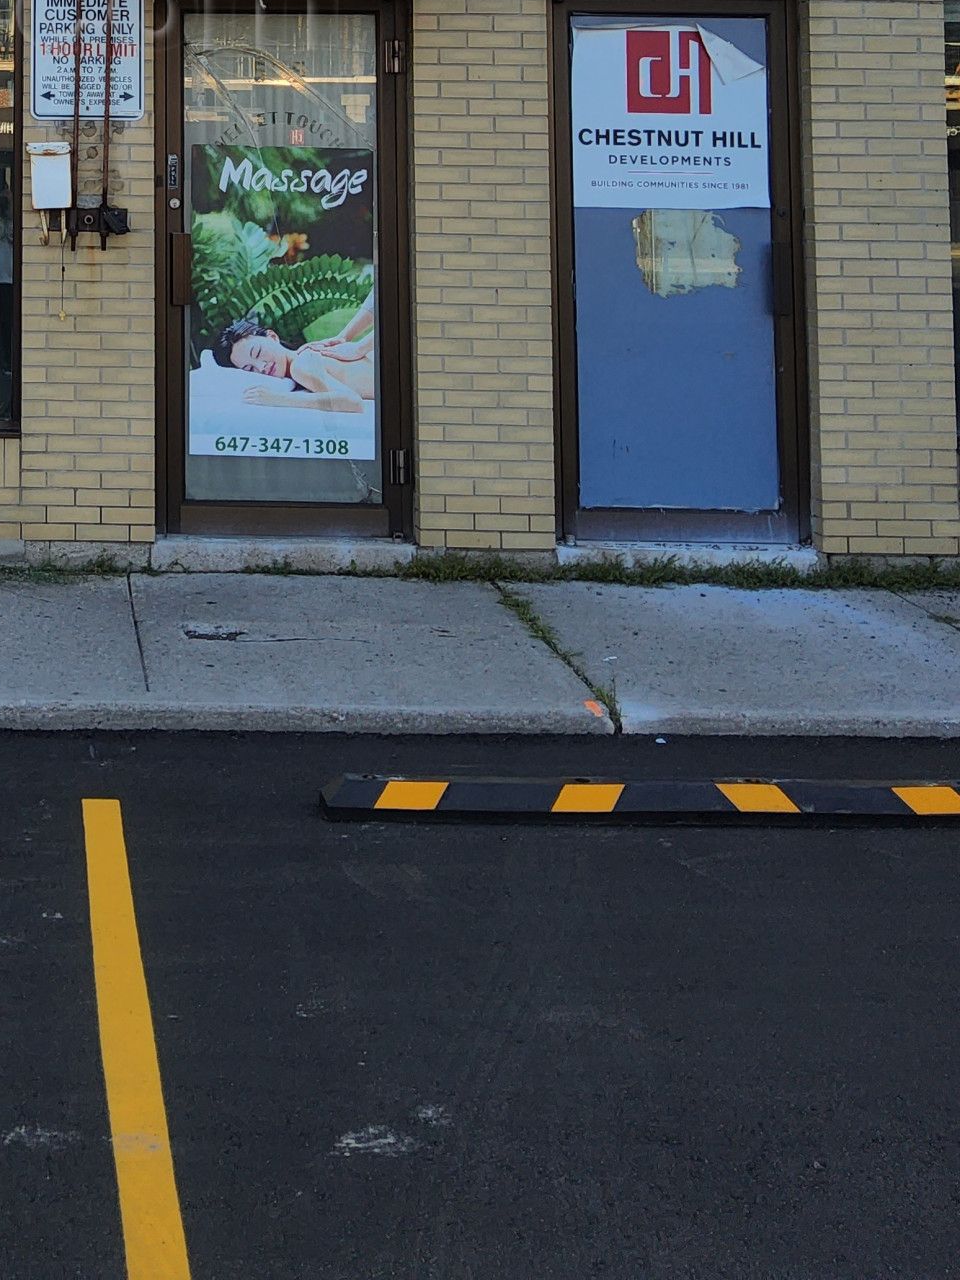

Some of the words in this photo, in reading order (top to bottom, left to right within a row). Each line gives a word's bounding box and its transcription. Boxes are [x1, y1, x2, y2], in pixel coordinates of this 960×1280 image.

[96, 43, 137, 58] LMIT
[53, 56, 69, 65] NO
[77, 56, 121, 65] ARKIG
[214, 111, 278, 148] VELET
[578, 128, 704, 147] CHESTNUT
[712, 130, 762, 149] HILL
[608, 154, 732, 167] DEVELOPMENTS
[219, 156, 368, 211] Massage
[591, 180, 634, 188] BUILDING
[637, 180, 699, 189] COMMUNITIES
[702, 182, 729, 190] SINCE
[732, 182, 750, 190] 1981
[215, 436, 350, 456] 647-347-1308
